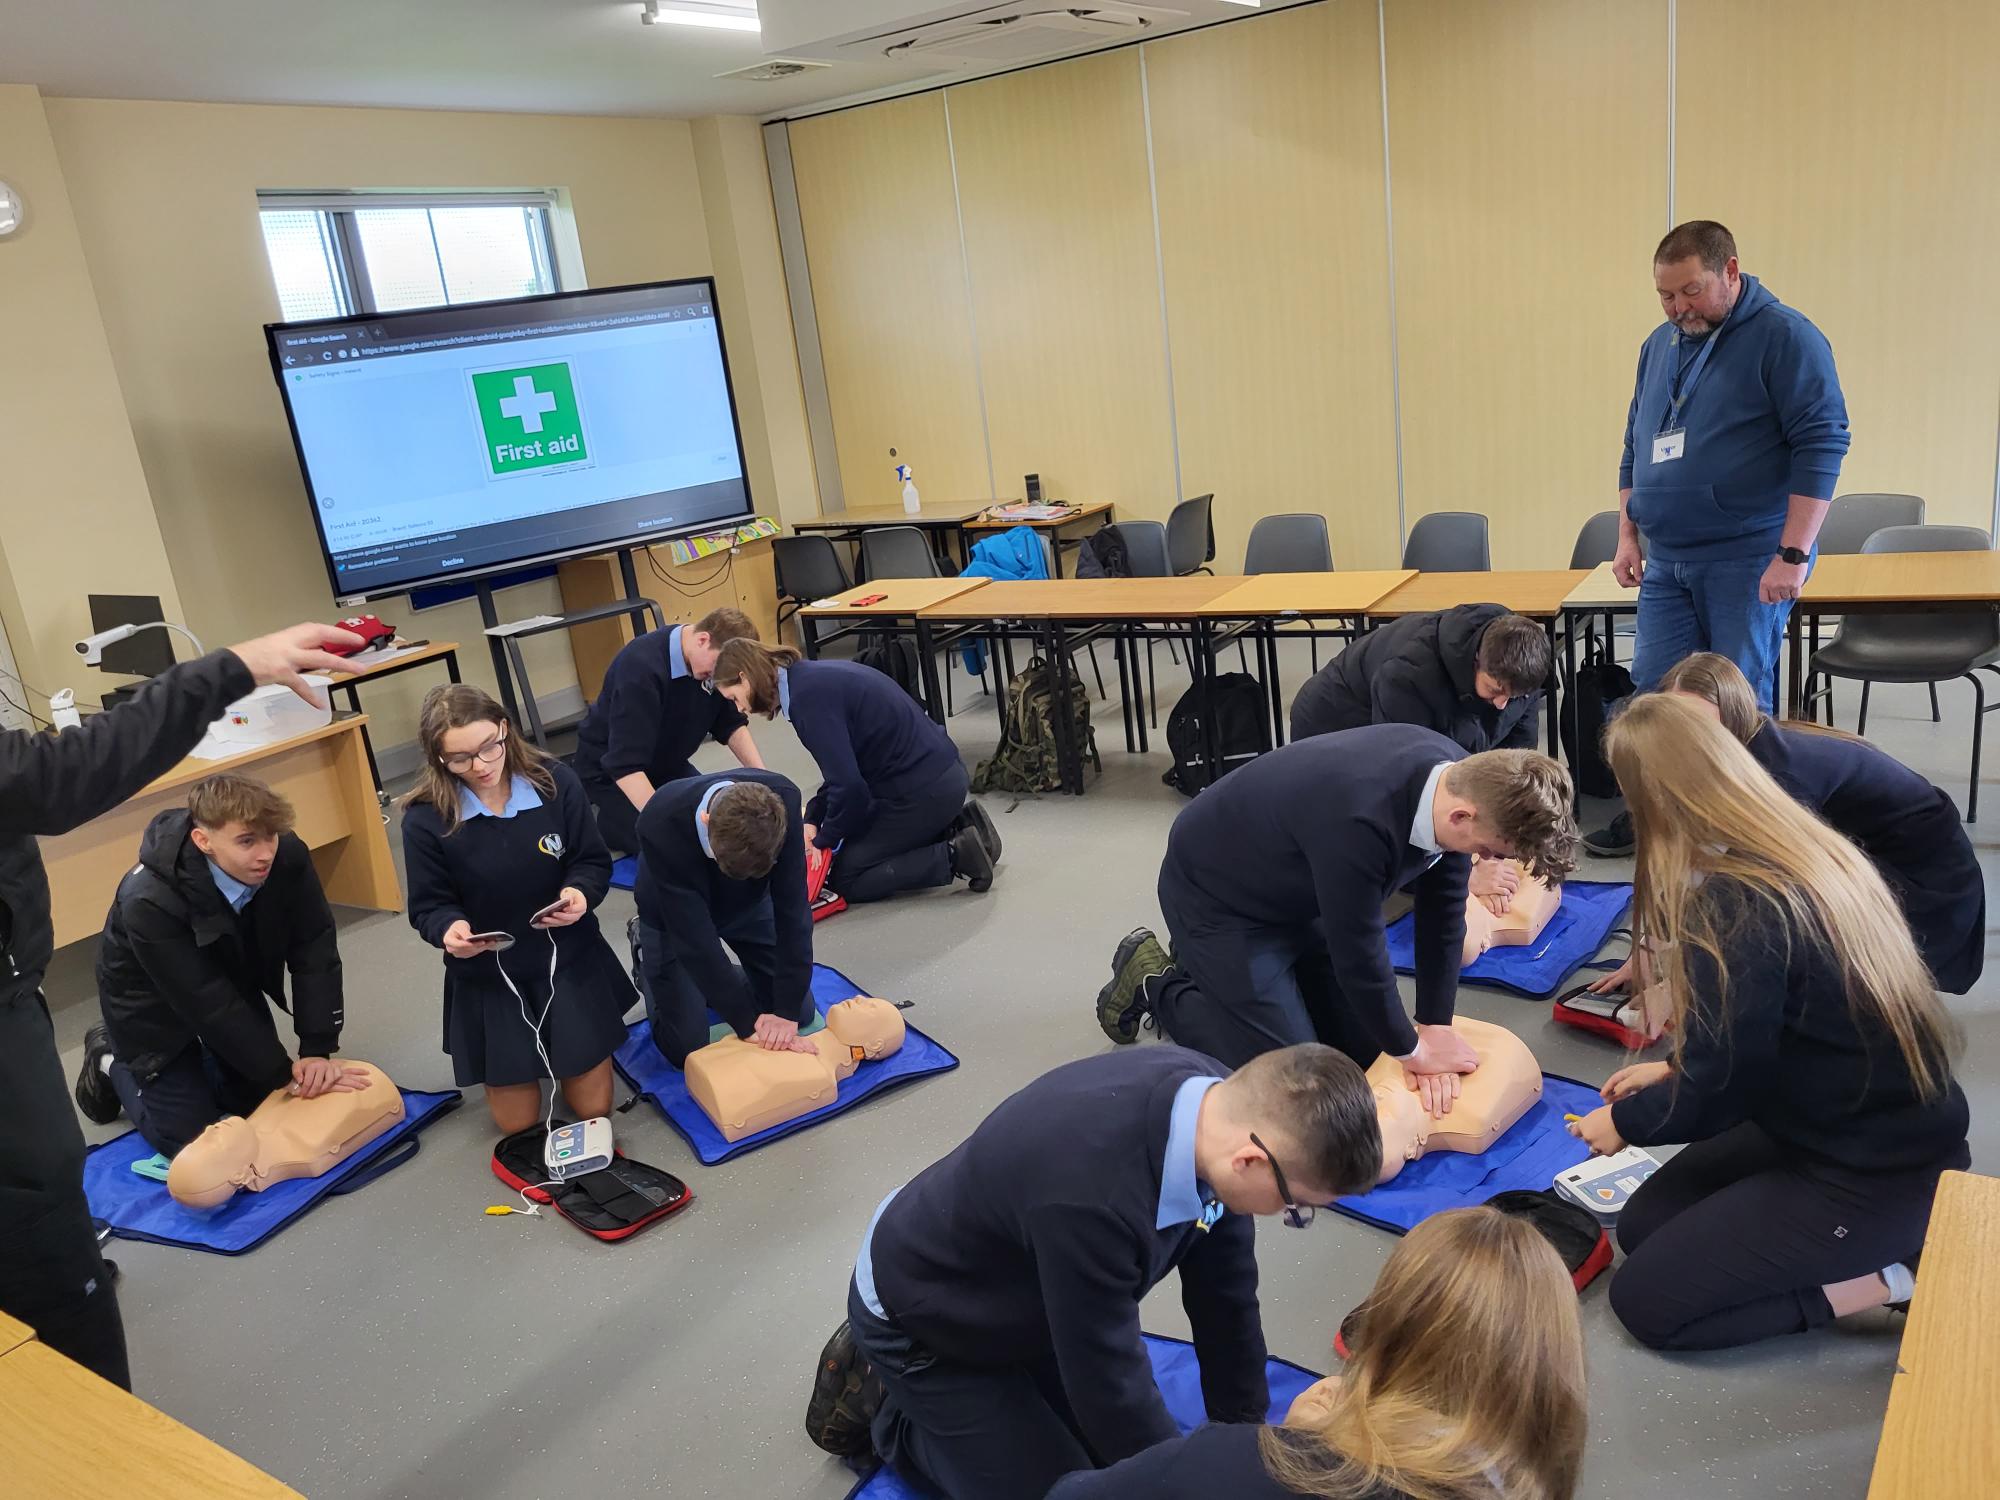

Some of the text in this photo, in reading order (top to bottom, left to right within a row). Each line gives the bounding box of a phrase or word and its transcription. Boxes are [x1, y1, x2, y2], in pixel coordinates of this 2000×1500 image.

[495, 433, 579, 464] First aid
[441, 556, 465, 568] Decline
